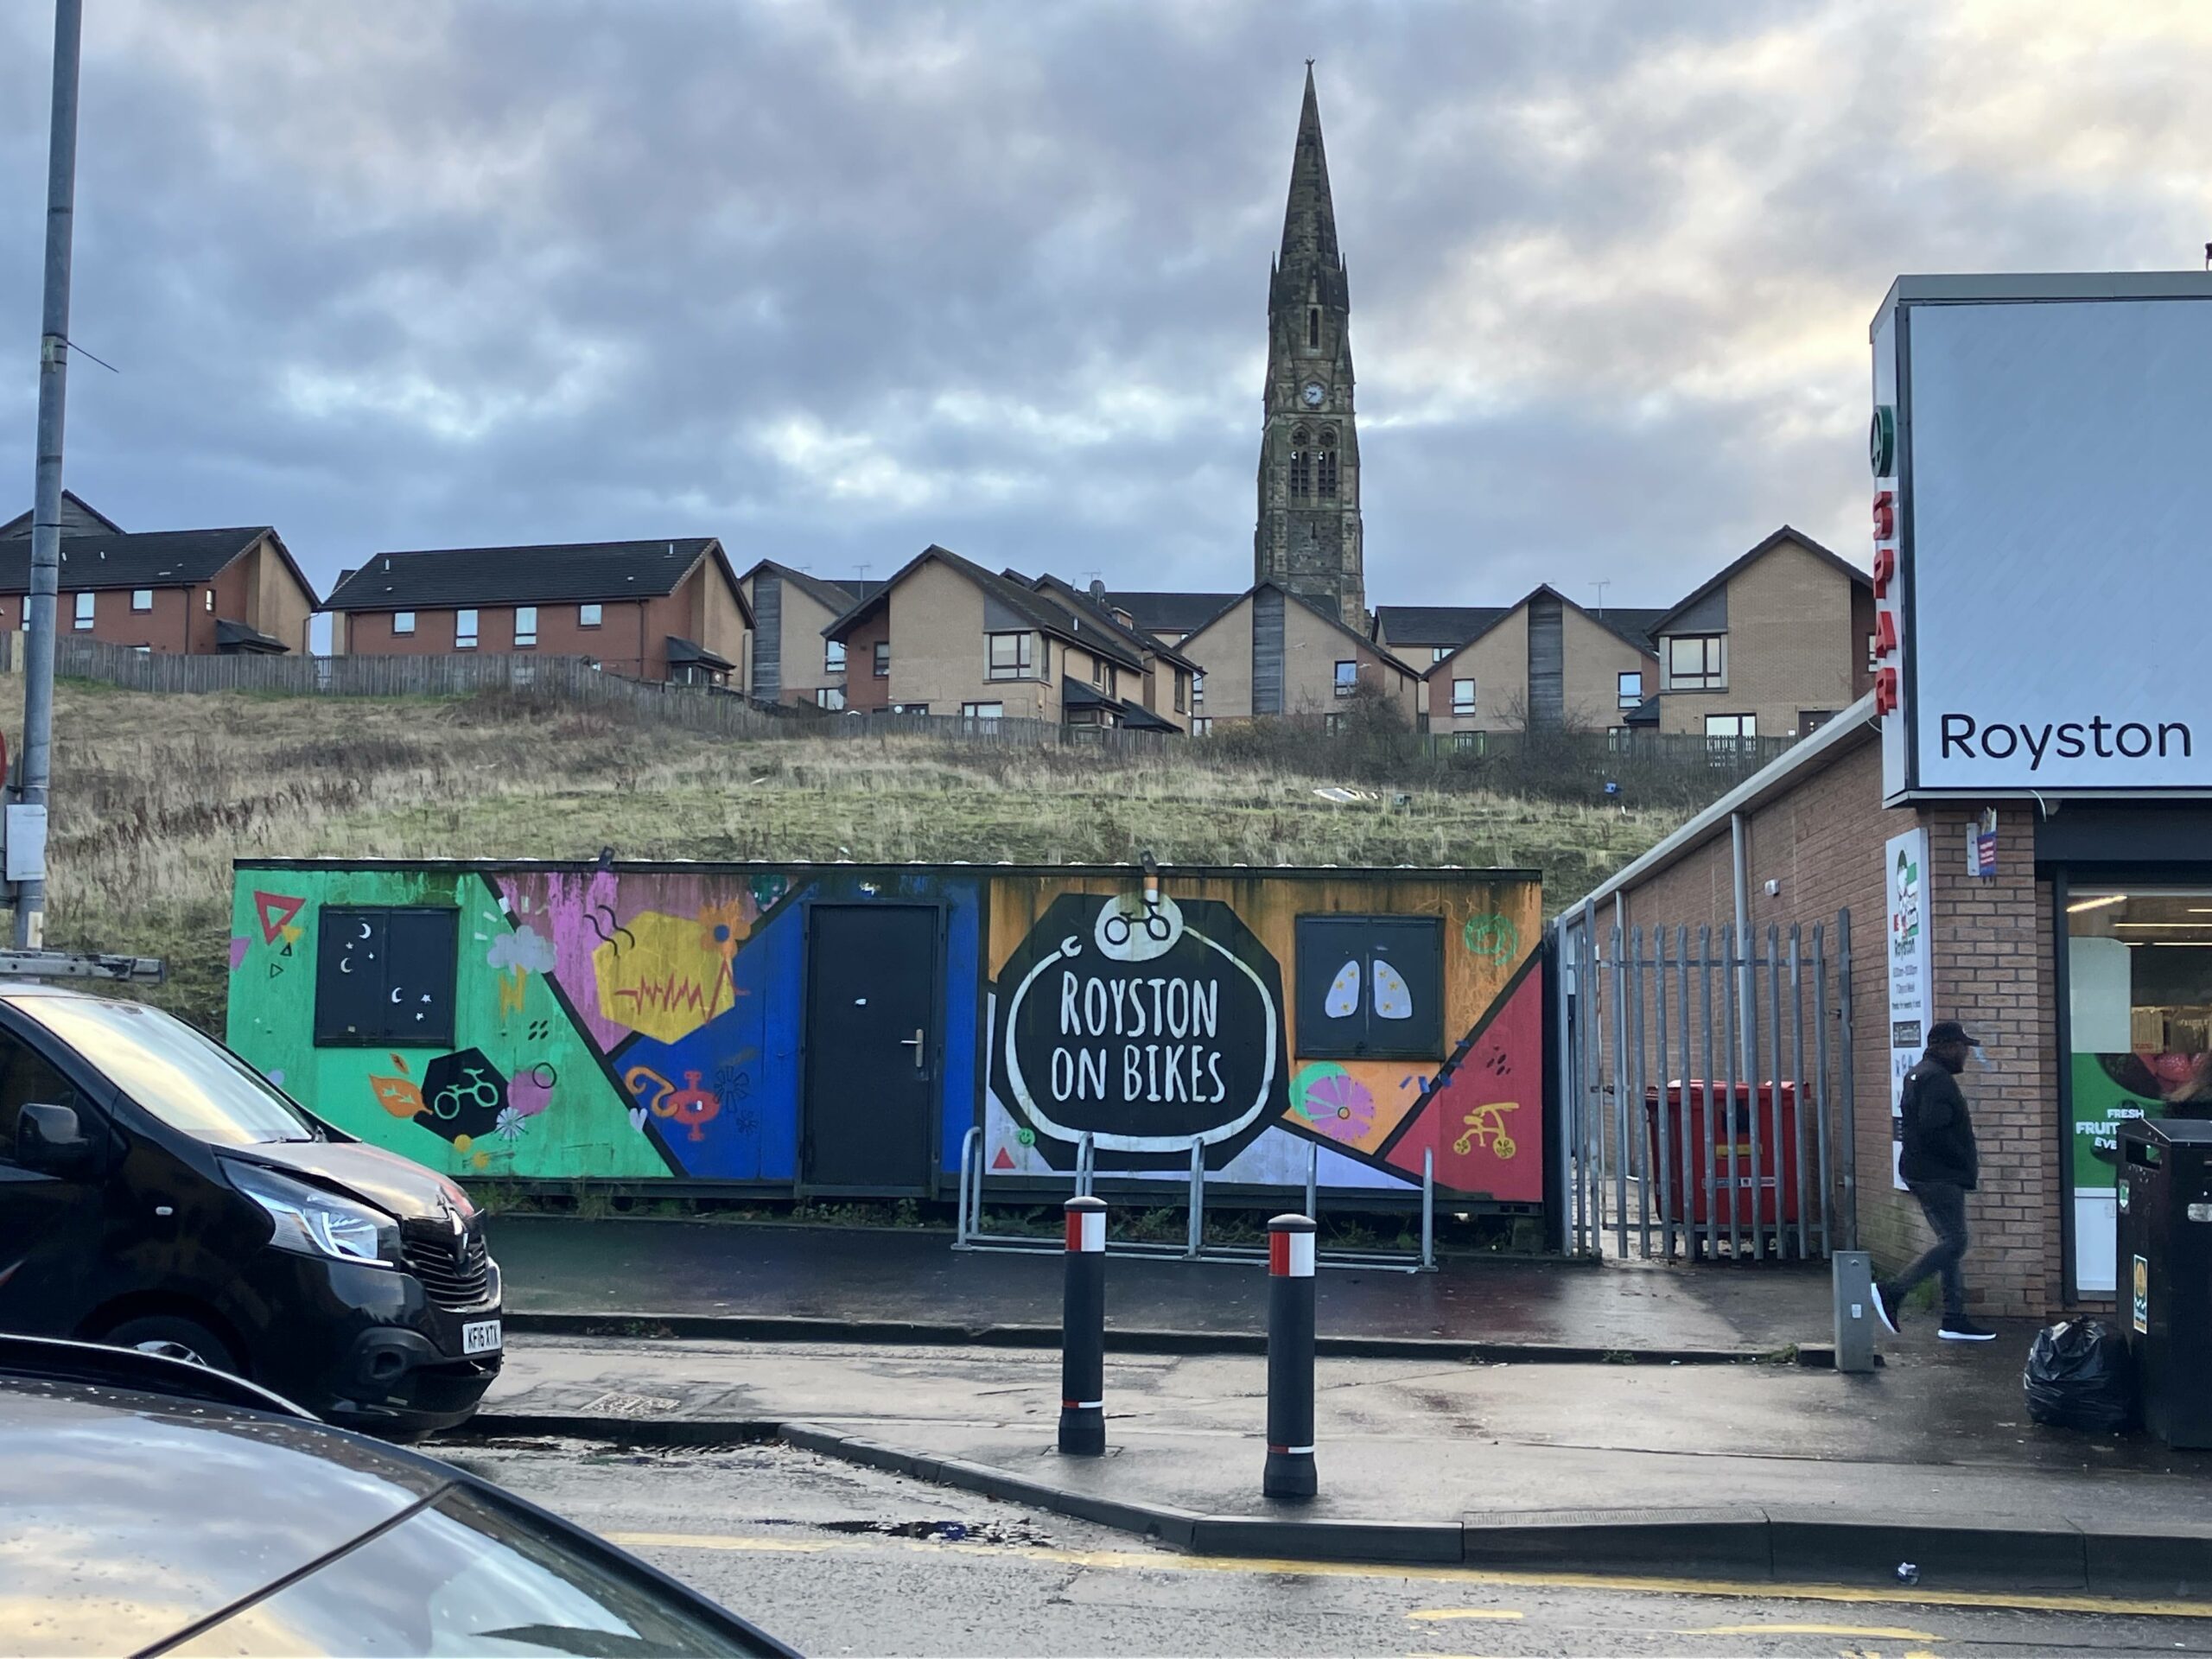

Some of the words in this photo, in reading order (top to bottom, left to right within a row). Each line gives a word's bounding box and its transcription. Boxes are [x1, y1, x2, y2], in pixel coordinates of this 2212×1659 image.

[1872, 491, 1897, 716] SPAR
[1941, 714, 2191, 771] Royston
[1061, 970, 1217, 1039] ROYSTON
[1052, 1046, 1107, 1103] ON
[1123, 1044, 1225, 1104] BIKES
[2094, 1136, 2118, 1150] EVE
[2107, 1109, 2145, 1119] FRESH
